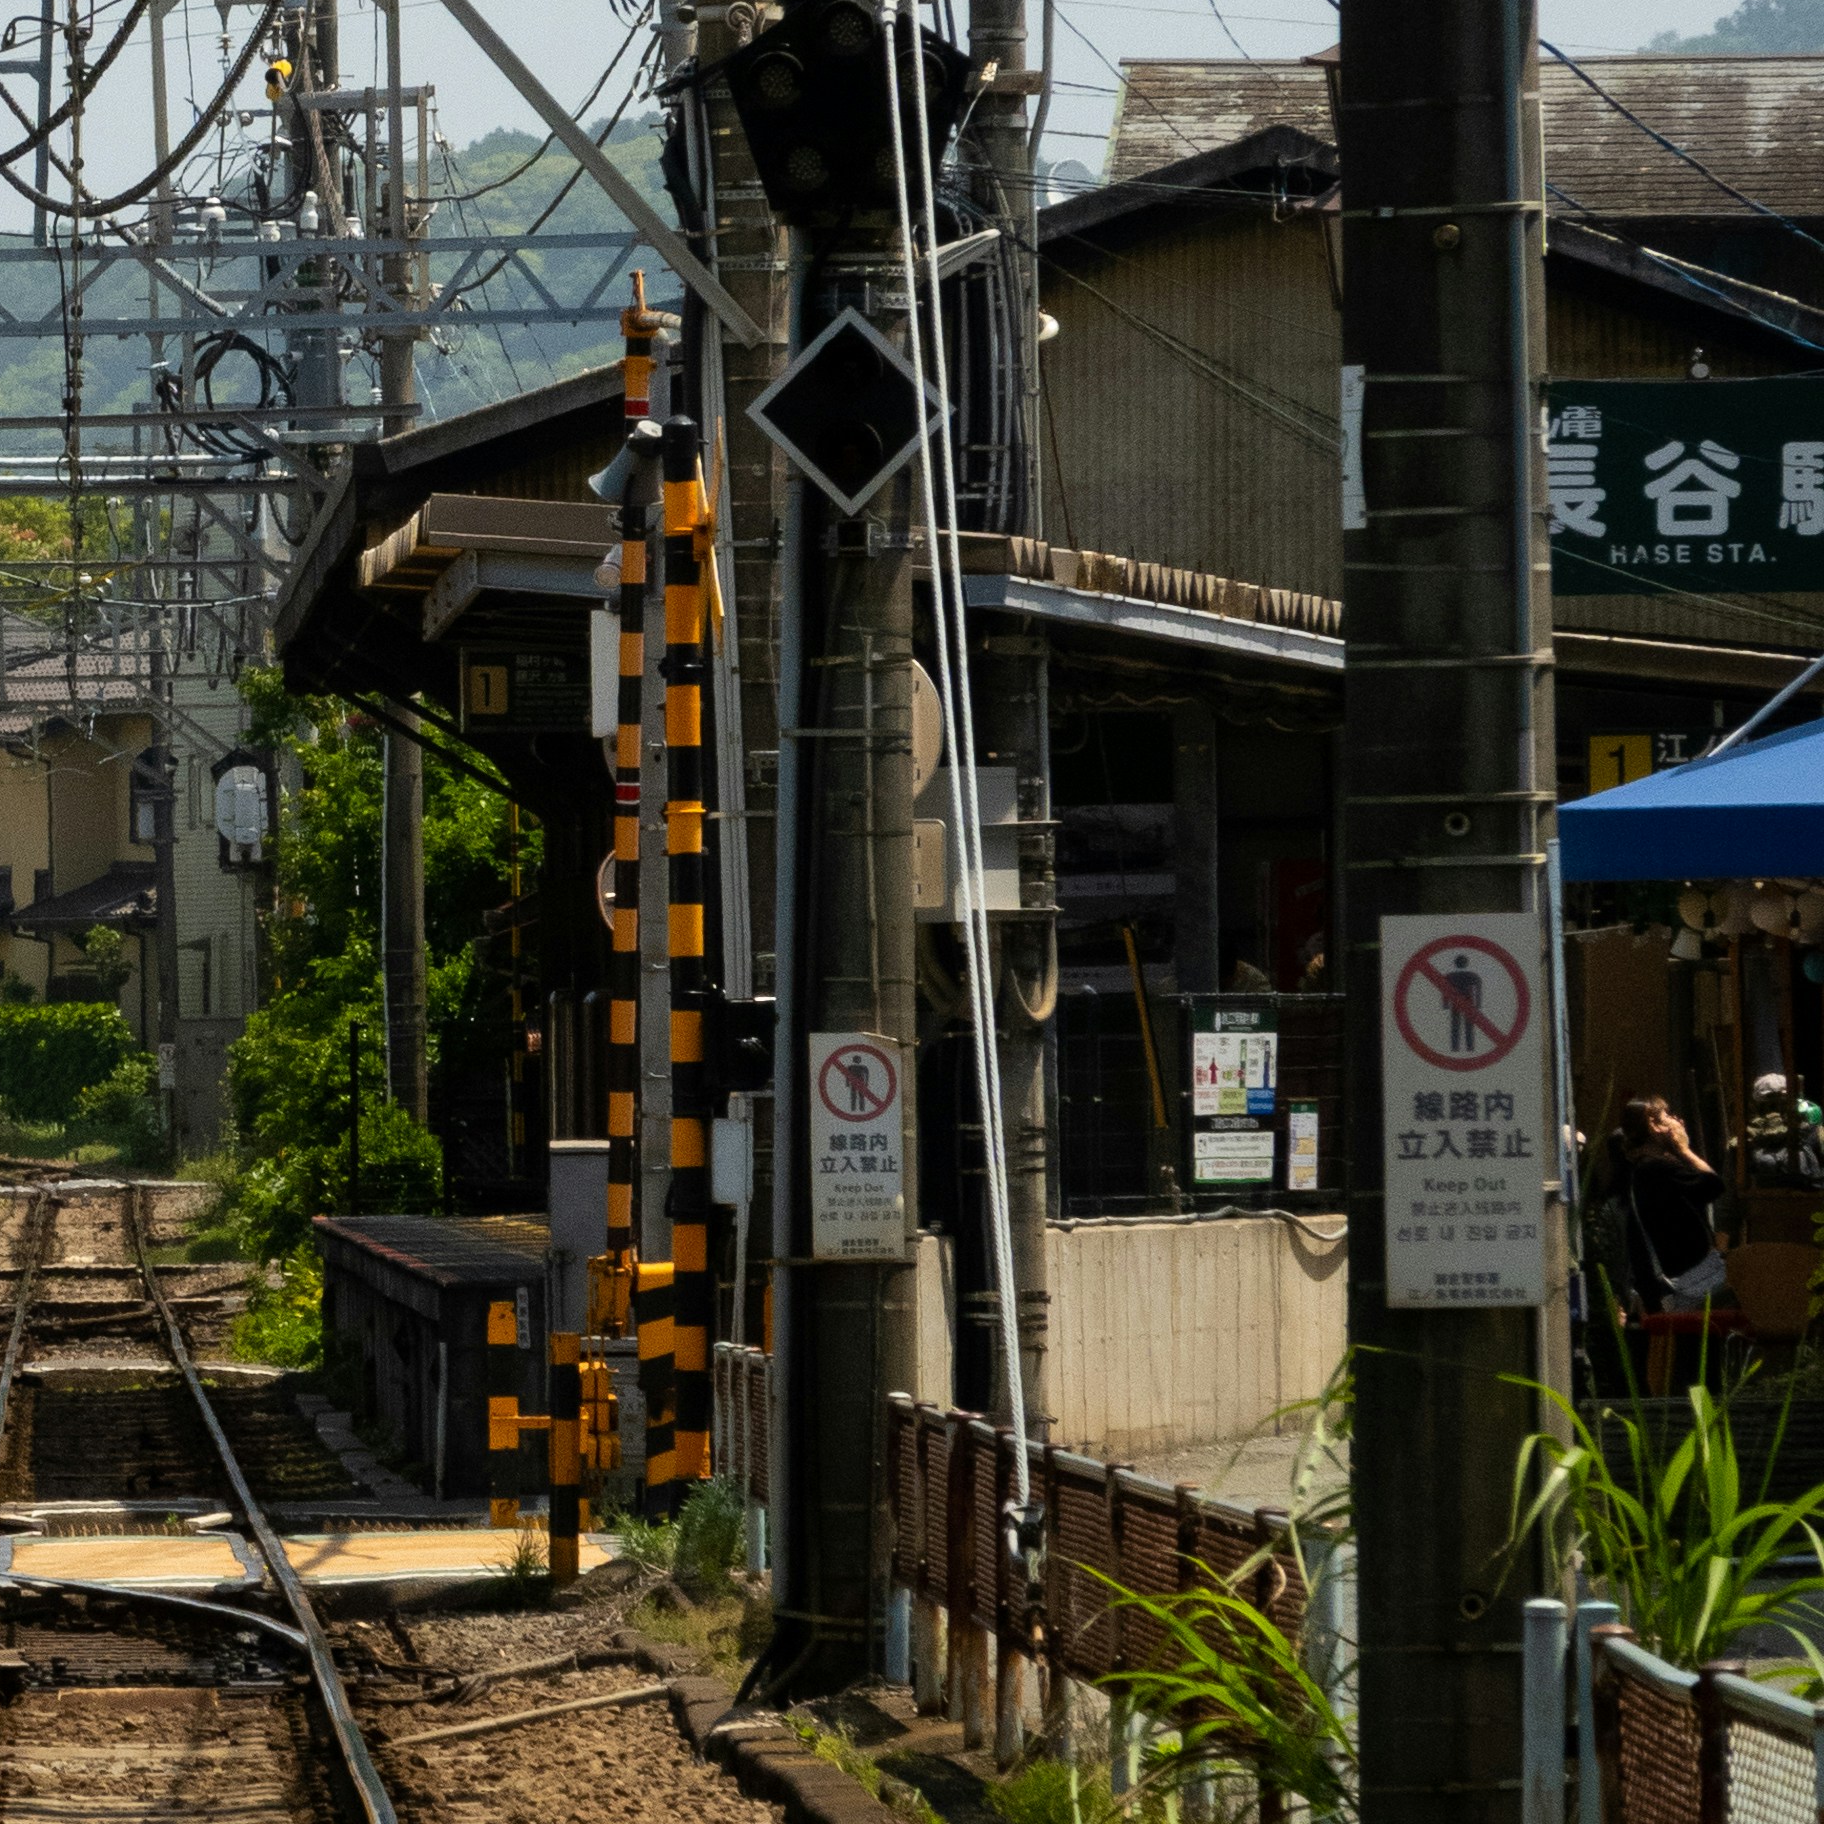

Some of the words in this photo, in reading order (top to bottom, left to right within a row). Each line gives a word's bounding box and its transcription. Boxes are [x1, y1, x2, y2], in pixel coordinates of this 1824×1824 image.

[1610, 544, 1692, 565] HASE
[1707, 543, 1778, 564] STA.
[479, 673, 491, 708] 1
[1609, 743, 1625, 786] 1
[1413, 1091, 1515, 1122] 線路内
[829, 1133, 888, 1152] 線路内
[1397, 1129, 1534, 1161] 立入禁止
[820, 1156, 898, 1174] 立入禁止
[1423, 1178, 1469, 1194] Keep
[1474, 1177, 1508, 1191] Out
